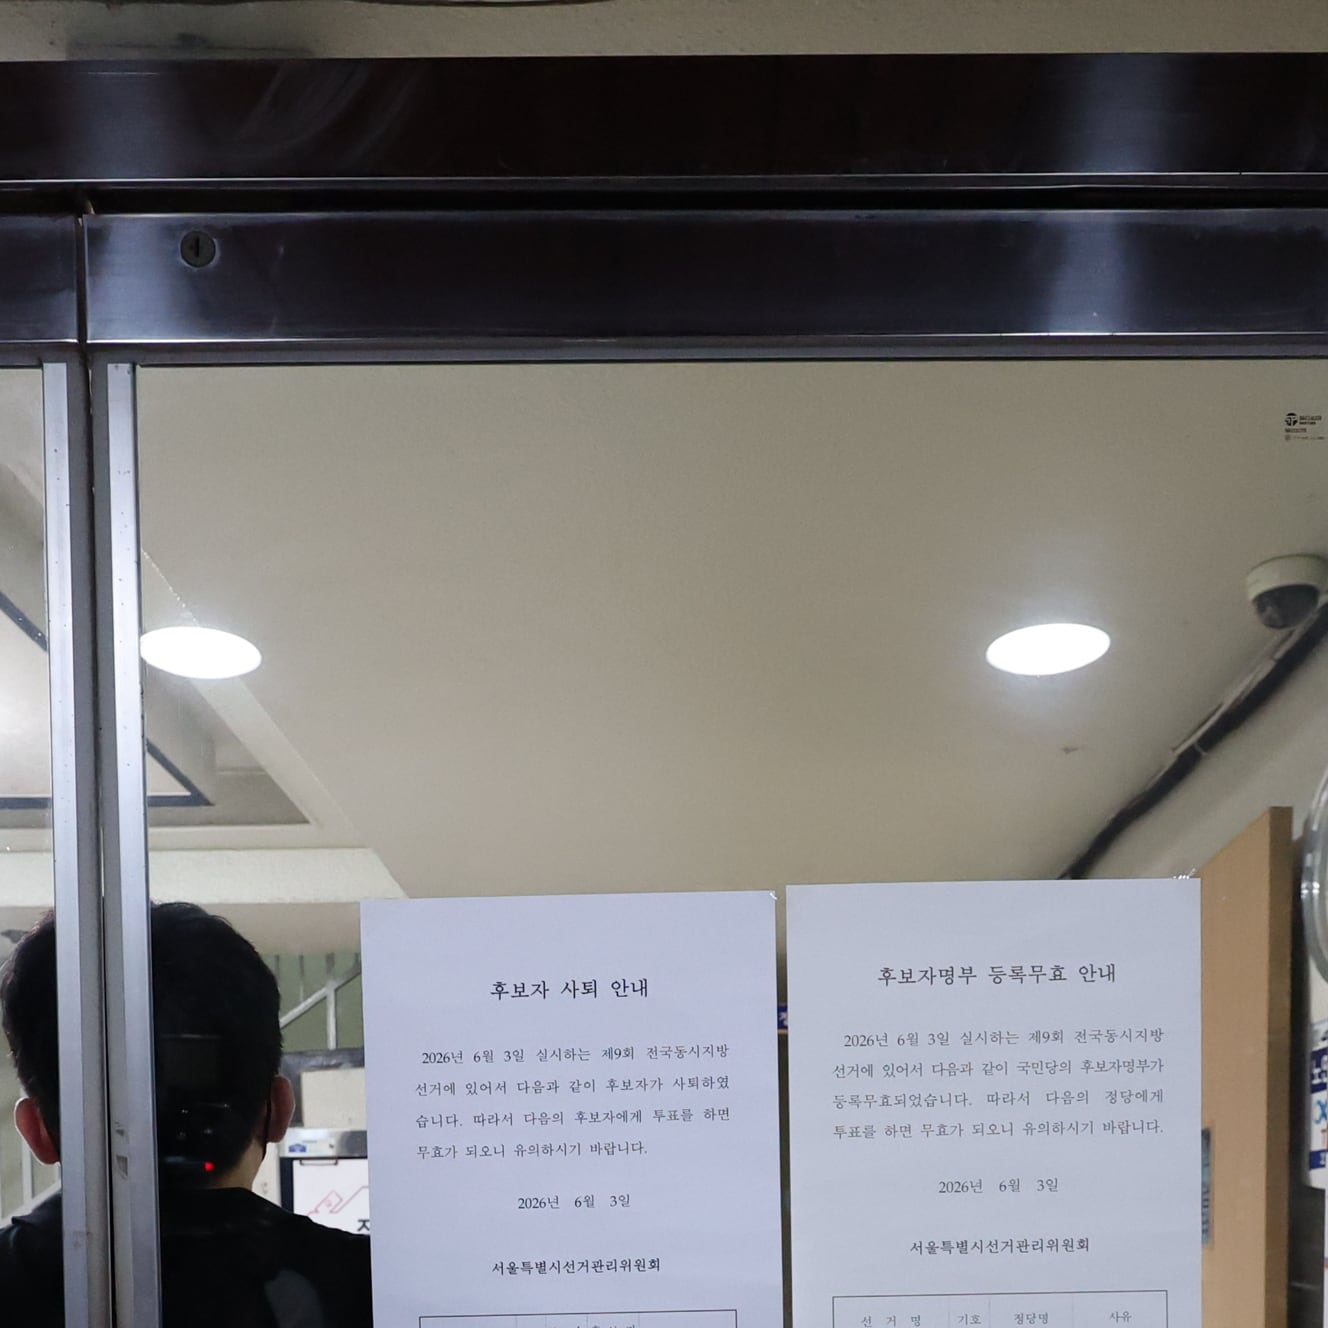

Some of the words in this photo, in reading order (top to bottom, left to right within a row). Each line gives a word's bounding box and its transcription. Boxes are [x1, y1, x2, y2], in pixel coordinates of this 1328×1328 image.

[878, 966, 976, 986] 후보자명부
[988, 965, 1067, 984] 등록무효
[1079, 963, 1115, 982] 안내
[491, 981, 549, 1000] 후보자
[561, 979, 596, 999] 사퇴
[611, 978, 647, 997] 안내
[844, 1033, 888, 1047] 2026년
[897, 1032, 918, 1046] 6월
[928, 1032, 949, 1046] 3일
[961, 1031, 1019, 1045] 실시하는
[1029, 1030, 1063, 1044] 제9회
[1075, 1028, 1164, 1043] 전국동시지방
[422, 1051, 462, 1064] 2026년
[474, 1050, 493, 1063] 6월
[504, 1049, 524, 1062] 3일
[536, 1048, 590, 1062] 실시하는
[602, 1047, 633, 1060] 제9회
[647, 1044, 729, 1059] 전국동시지방
[833, 1064, 873, 1078] 선거에
[883, 1063, 922, 1078] 있어서
[932, 1062, 973, 1077] 다음과
[982, 1061, 1007, 1075] 같이
[1017, 1060, 1071, 1075] 국민당의
[1080, 1058, 1164, 1074] 후보자명부가
[416, 1082, 455, 1096] 선거에
[466, 1081, 506, 1095] 있어서
[517, 1080, 559, 1094] 다음과
[570, 1079, 595, 1093] 같이
[606, 1077, 663, 1092] 후보자가
[673, 1076, 729, 1090] 사퇴하였
[833, 1092, 972, 1109] 등록무효되었습니다.
[987, 1091, 1029, 1106] 따라서
[1046, 1090, 1088, 1105] 다음의
[1106, 1089, 1163, 1104] 정당에게
[416, 1114, 462, 1128] 습니다.
[474, 1113, 512, 1126] 따라서
[524, 1112, 563, 1125] 다음의
[575, 1109, 641, 1124] 후보자에게
[653, 1109, 693, 1122] 투표를
[704, 1107, 729, 1120] 하면
[833, 1125, 876, 1139] 투표를
[885, 1124, 912, 1138] 하면
[921, 1123, 964, 1138] 무효가
[972, 1122, 1013, 1136] 되오니
[1023, 1121, 1093, 1136] 유의하시기
[1103, 1119, 1163, 1135] 바랍니다.
[417, 1145, 457, 1160] 무효가
[466, 1144, 504, 1158] 되오니
[514, 1143, 580, 1157] 유의하시기
[590, 1141, 647, 1155] 바랍니다.
[939, 1179, 982, 1193] 2026년
[999, 1178, 1020, 1192] 6월
[1037, 1178, 1058, 1192] 3일
[518, 1196, 559, 1209] 2026년
[575, 1195, 594, 1208] 6월
[610, 1194, 629, 1207] 3일
[911, 1238, 1088, 1255] 서울특별시선거관리위원회
[492, 1258, 659, 1276] 서울특별시선거관리위원회
[958, 1313, 981, 1326] 기호
[1014, 1312, 1049, 1325] 정당명
[1110, 1311, 1132, 1323] 사유
